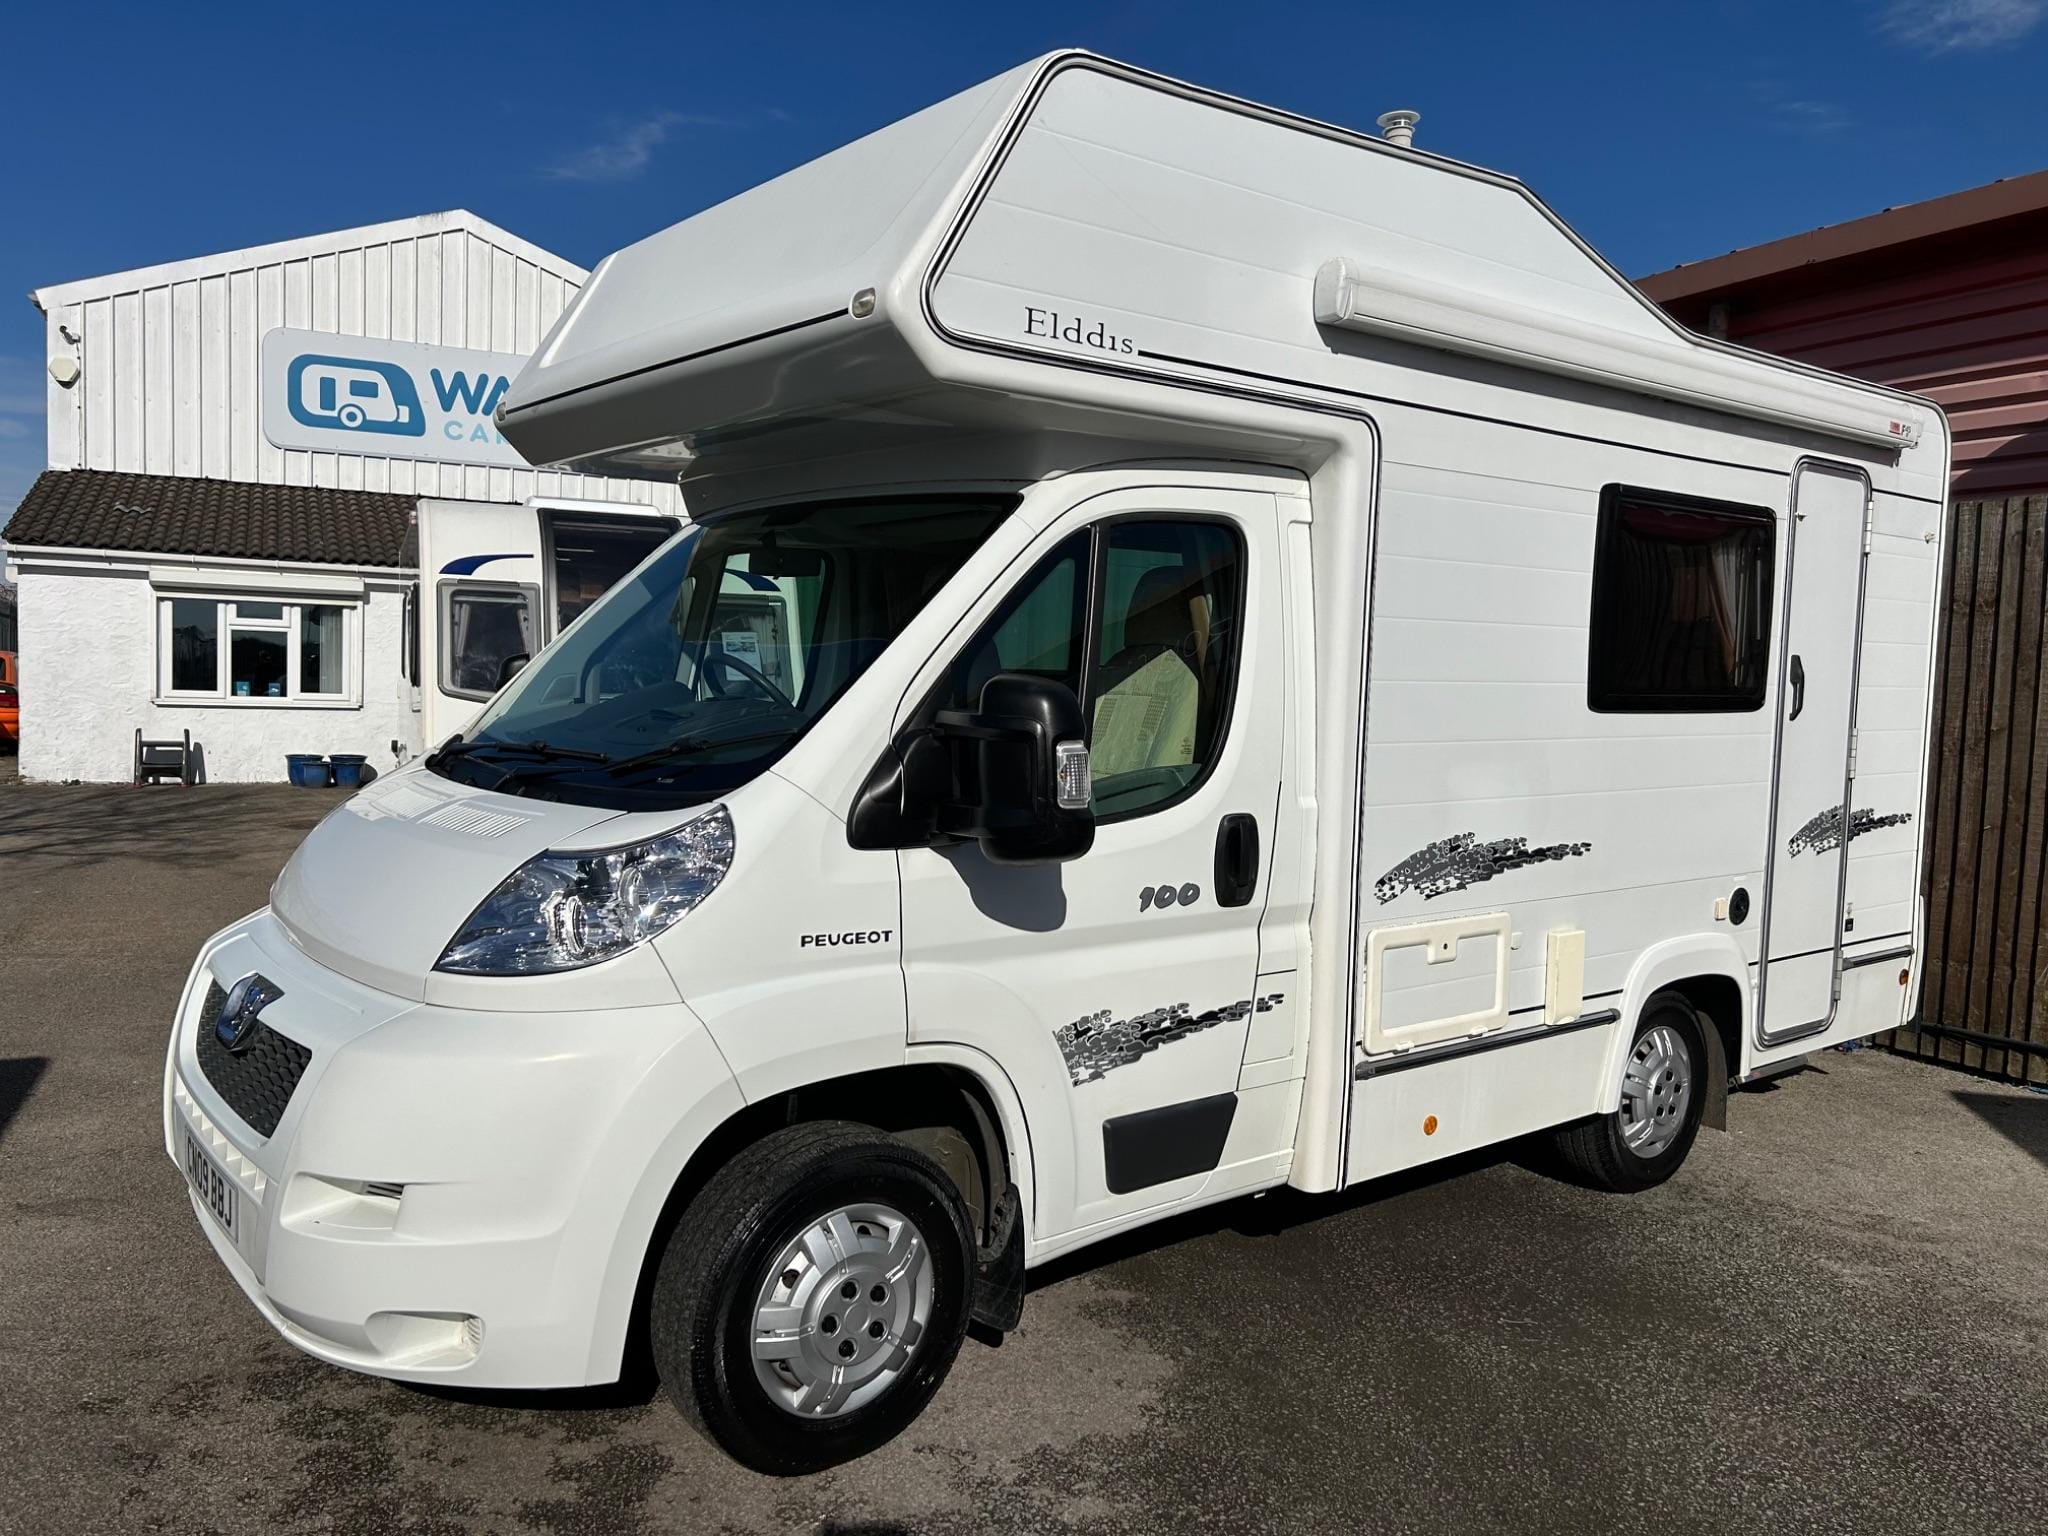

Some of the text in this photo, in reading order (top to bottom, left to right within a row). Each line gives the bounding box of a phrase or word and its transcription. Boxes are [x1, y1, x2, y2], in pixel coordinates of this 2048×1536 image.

[1024, 306, 1133, 354] Elddis
[1139, 882, 1201, 913] 100
[800, 930, 893, 948] PEUGEOT
[187, 1135, 233, 1228] CN09 BBJ
